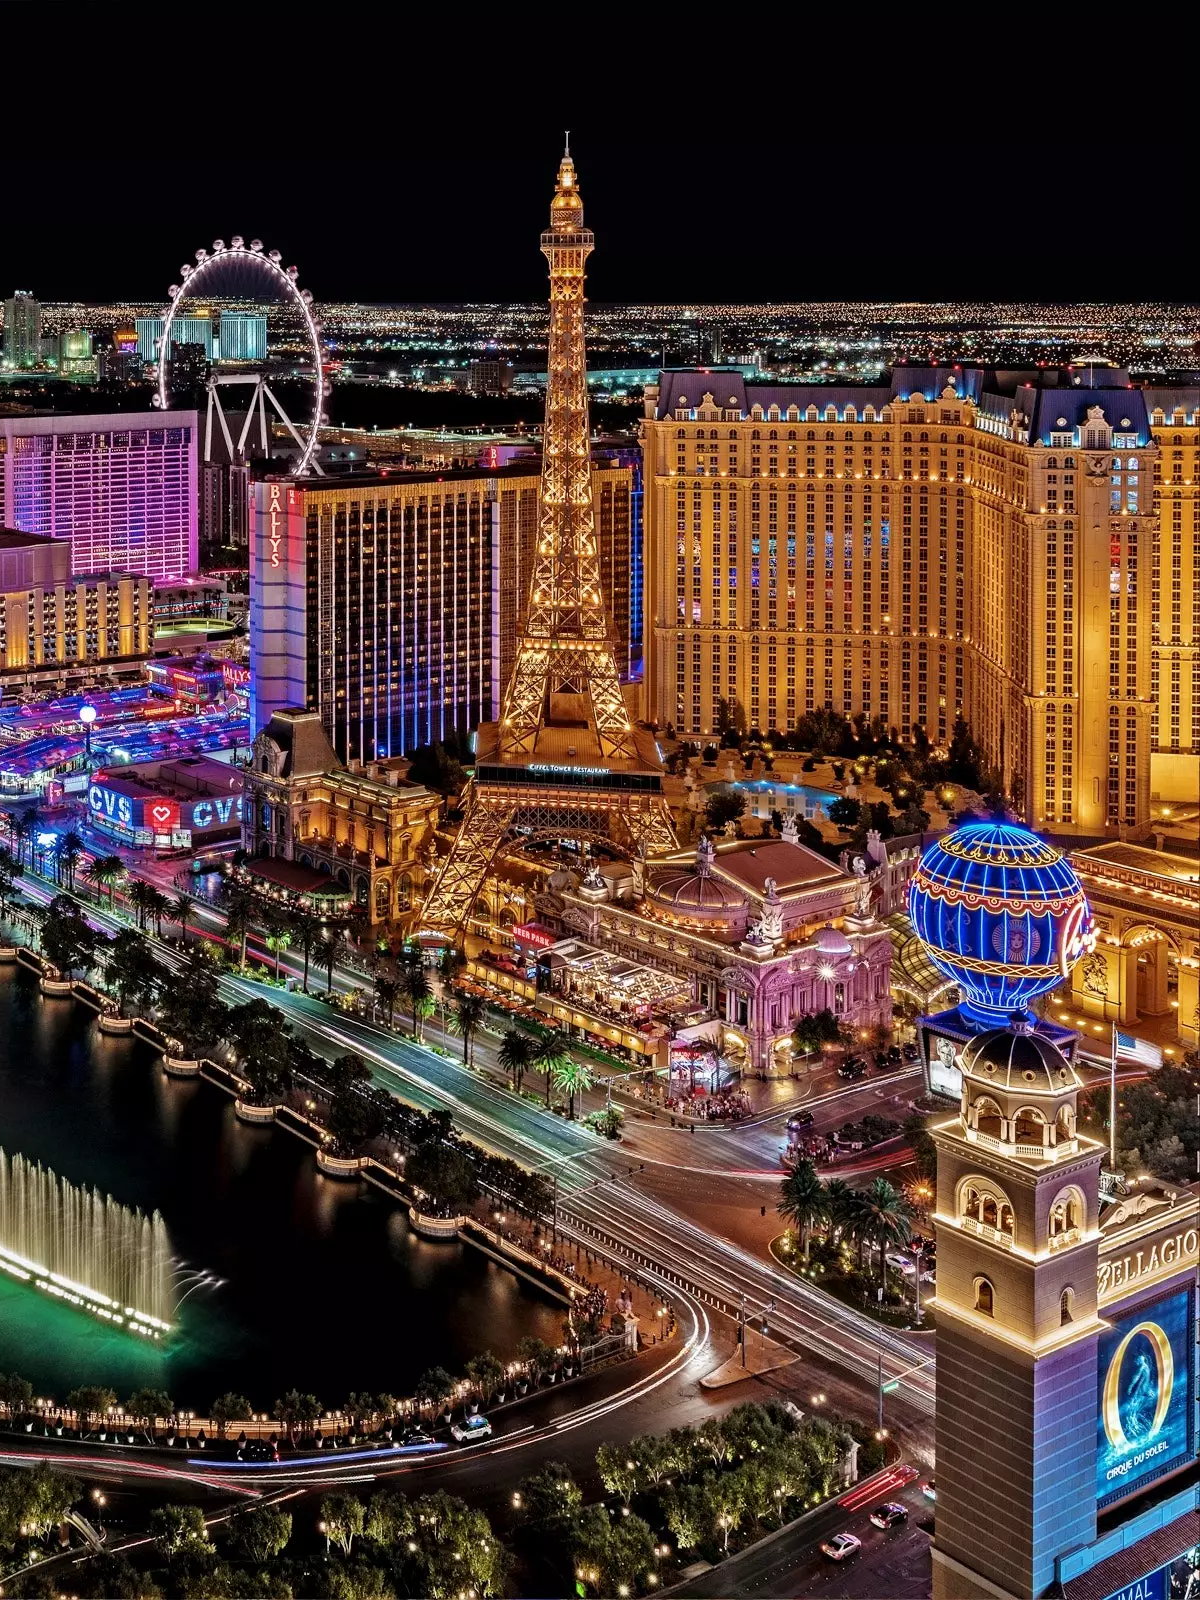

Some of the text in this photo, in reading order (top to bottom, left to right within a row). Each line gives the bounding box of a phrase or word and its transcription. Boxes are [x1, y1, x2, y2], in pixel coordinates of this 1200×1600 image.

[529, 763, 610, 774] EIFFEL TOWER RESTAURANT
[89, 785, 131, 822] CVS
[513, 927, 550, 946] BEER PARK
[1097, 1229, 1197, 1295] BELLAGIO
[1106, 1440, 1170, 1480] CIRQUE DU SOLEIL
